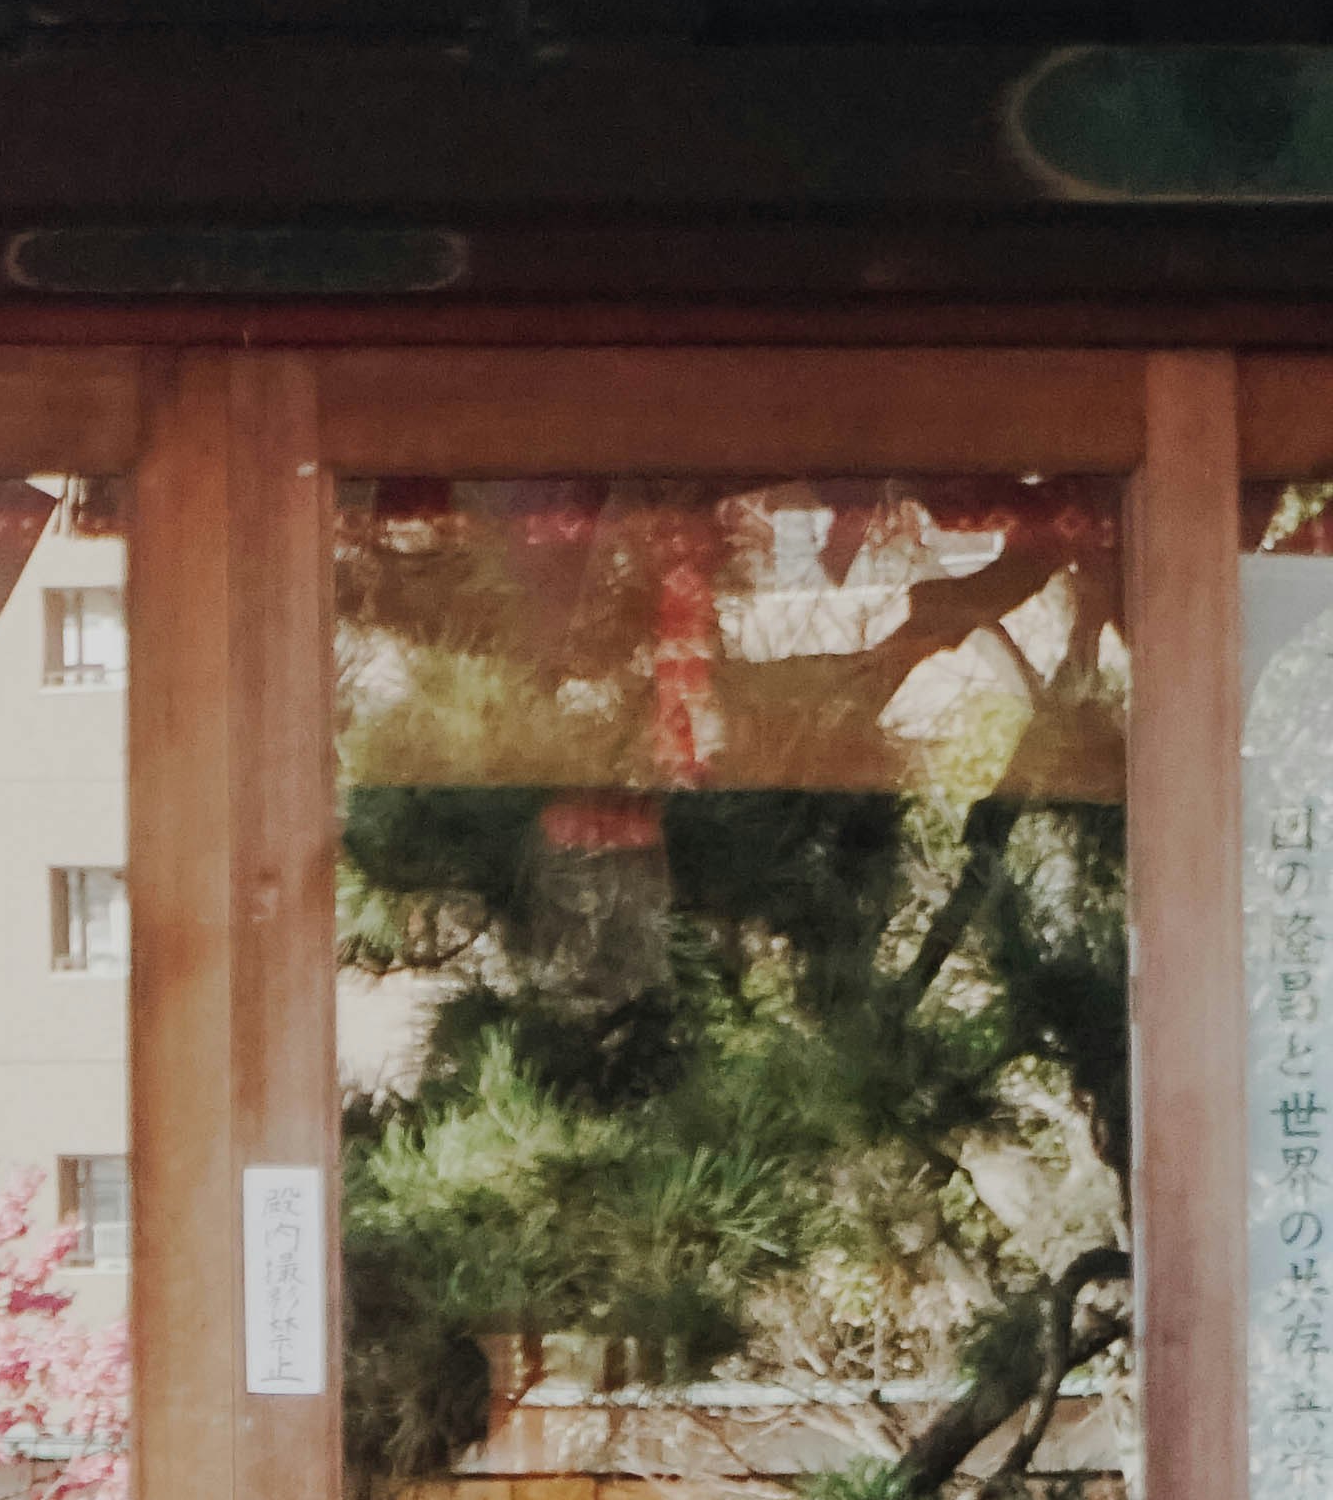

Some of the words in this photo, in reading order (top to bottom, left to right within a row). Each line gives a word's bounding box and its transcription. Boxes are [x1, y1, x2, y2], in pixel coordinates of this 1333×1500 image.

[260, 1187, 305, 1383] 殿内撮影禁止
